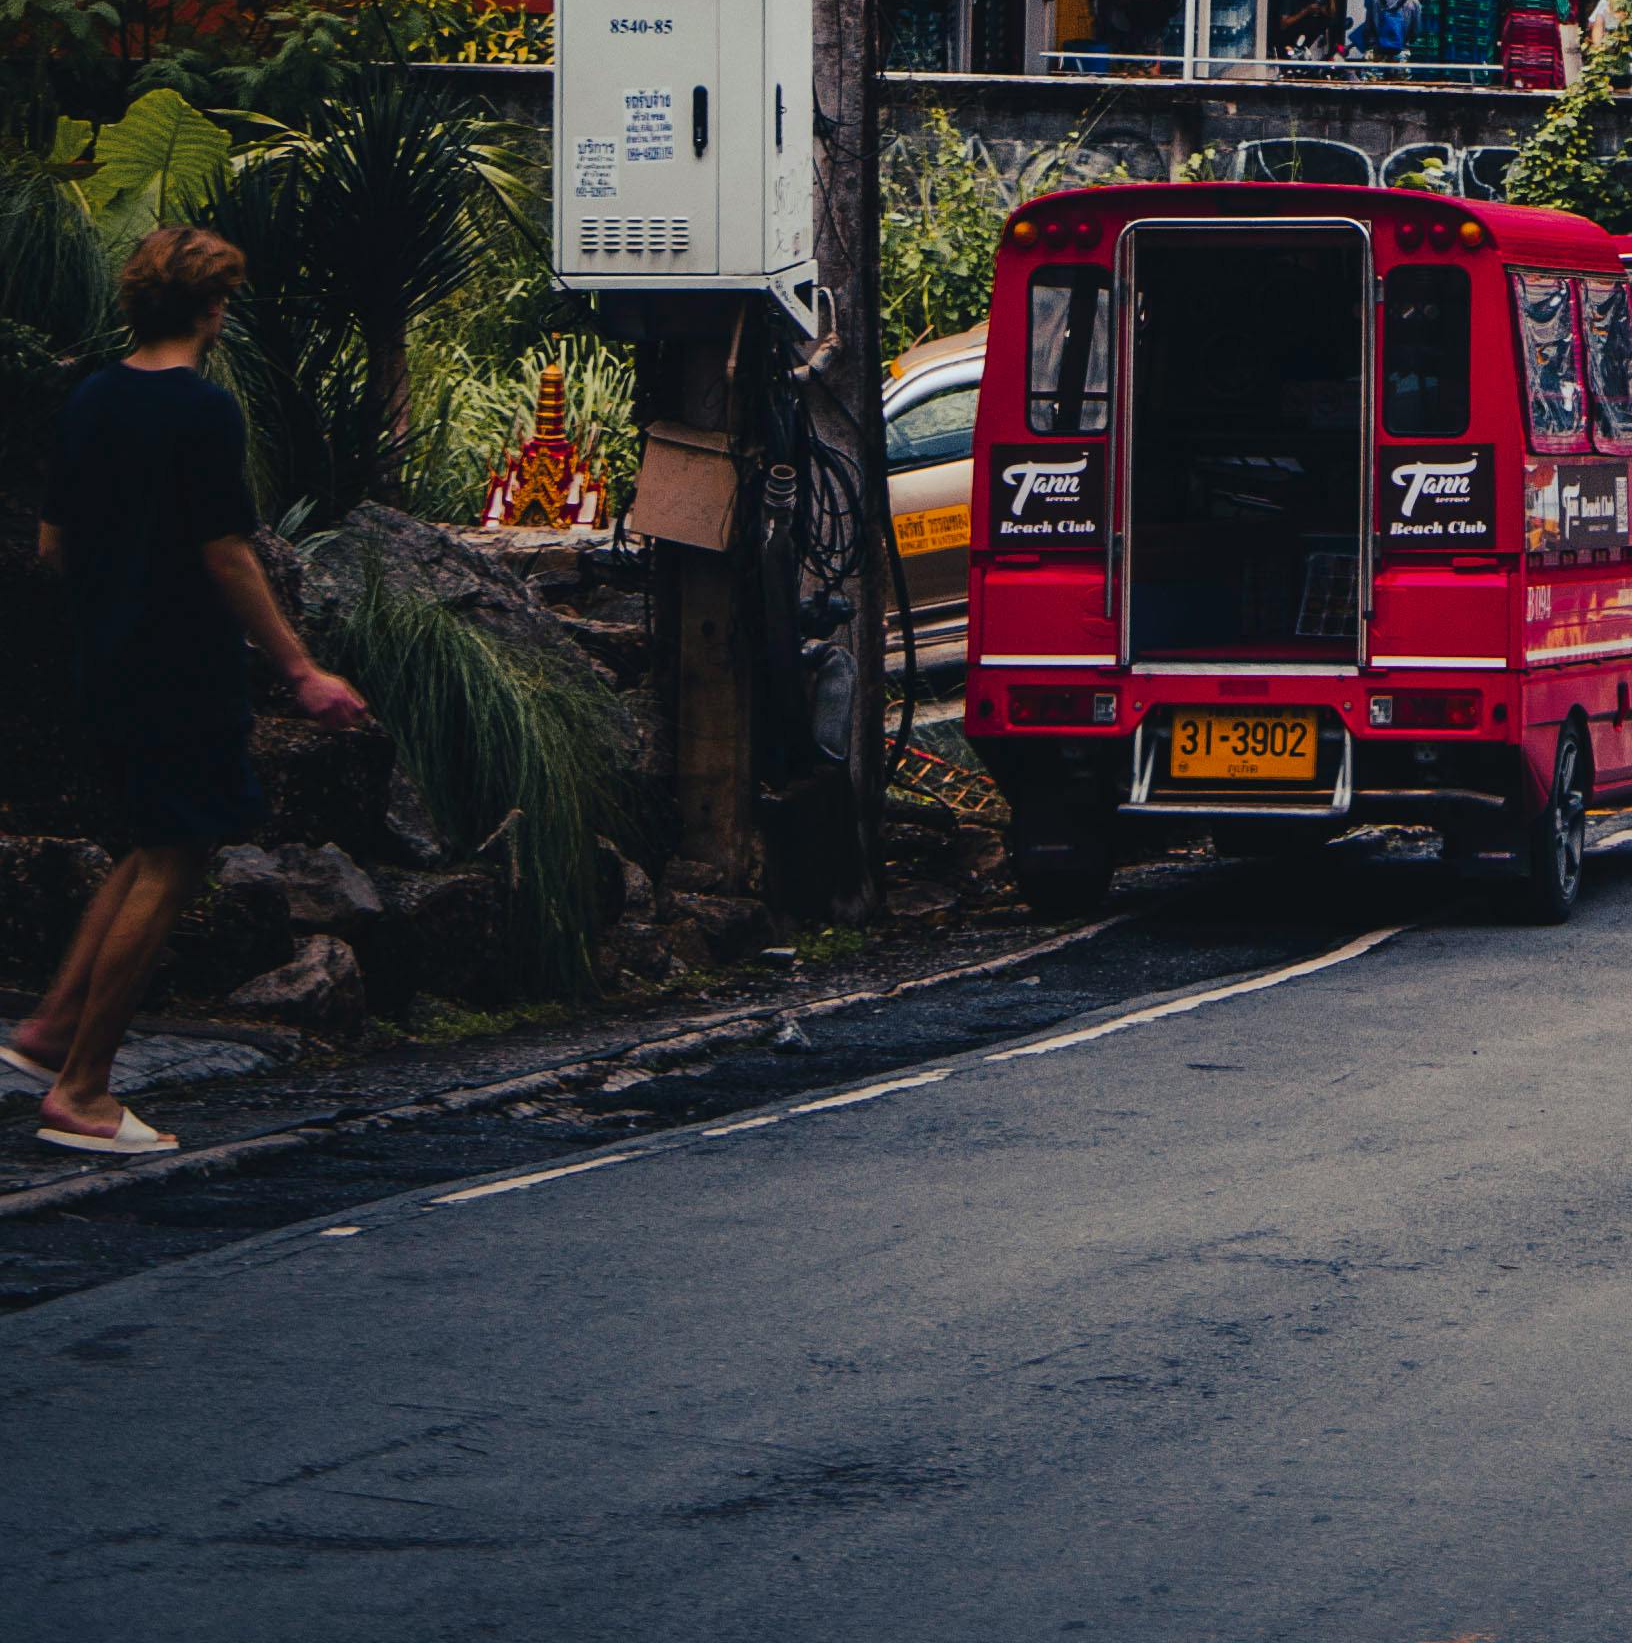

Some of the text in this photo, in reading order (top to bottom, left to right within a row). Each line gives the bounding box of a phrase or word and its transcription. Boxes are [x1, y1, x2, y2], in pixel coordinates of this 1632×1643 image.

[609, 19, 673, 34] 8540-85
[1002, 457, 1088, 516] Tann
[1391, 459, 1478, 517] Tann
[1000, 519, 1096, 534] Beach Club
[1390, 519, 1487, 535] Beach Club
[1180, 719, 1308, 758] 31-3902
